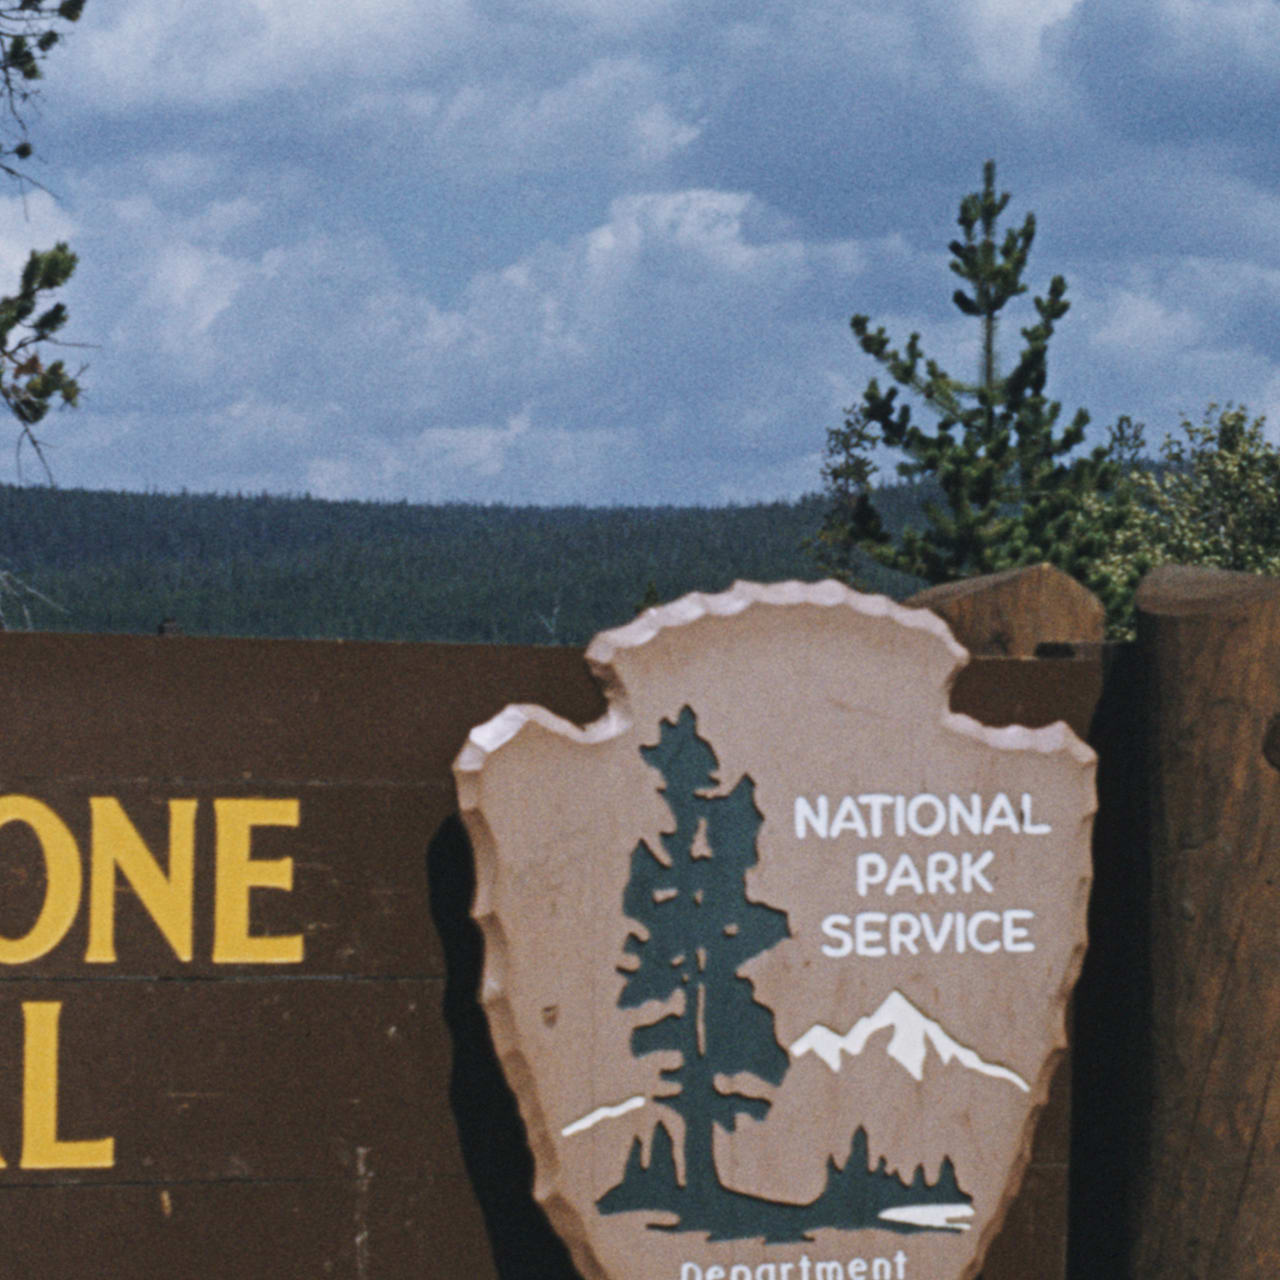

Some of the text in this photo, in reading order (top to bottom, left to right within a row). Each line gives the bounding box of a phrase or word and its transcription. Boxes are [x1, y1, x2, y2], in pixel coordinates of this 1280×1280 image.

[793, 791, 1053, 840] NATIONAL
[855, 850, 995, 897] PARK
[820, 908, 1036, 959] SERVICE
